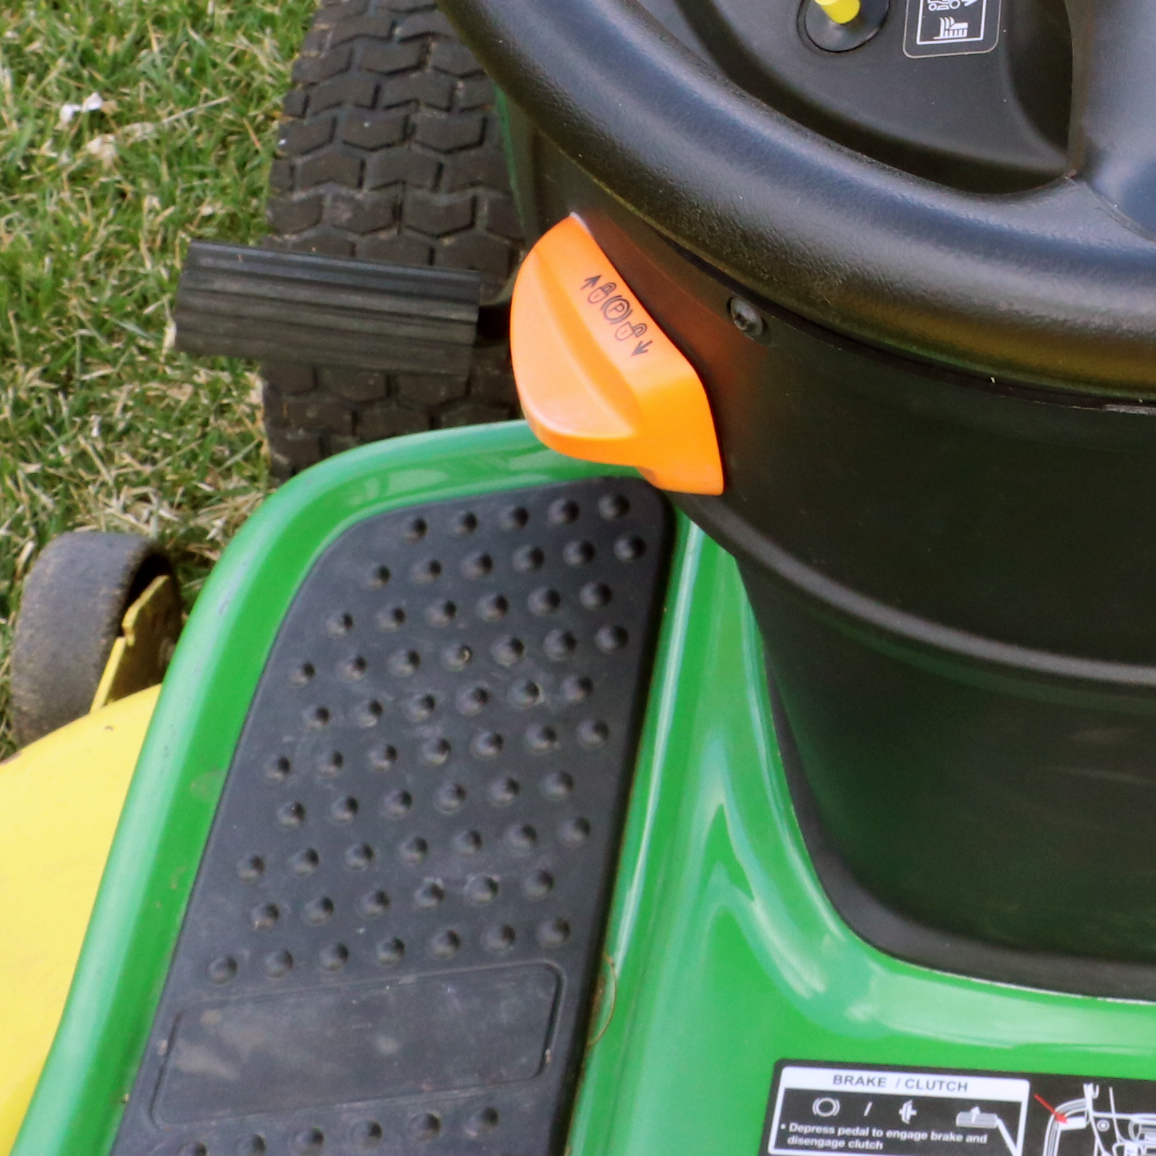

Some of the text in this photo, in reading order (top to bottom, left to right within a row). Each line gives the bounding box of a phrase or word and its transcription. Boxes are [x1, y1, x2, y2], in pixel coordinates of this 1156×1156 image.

[832, 1074, 887, 1088] BRAKE
[904, 1078, 968, 1092] CLUTCH
[787, 1134, 883, 1150] disengage clutch
[789, 1122, 988, 1144] Depress pedal to engage brake and
